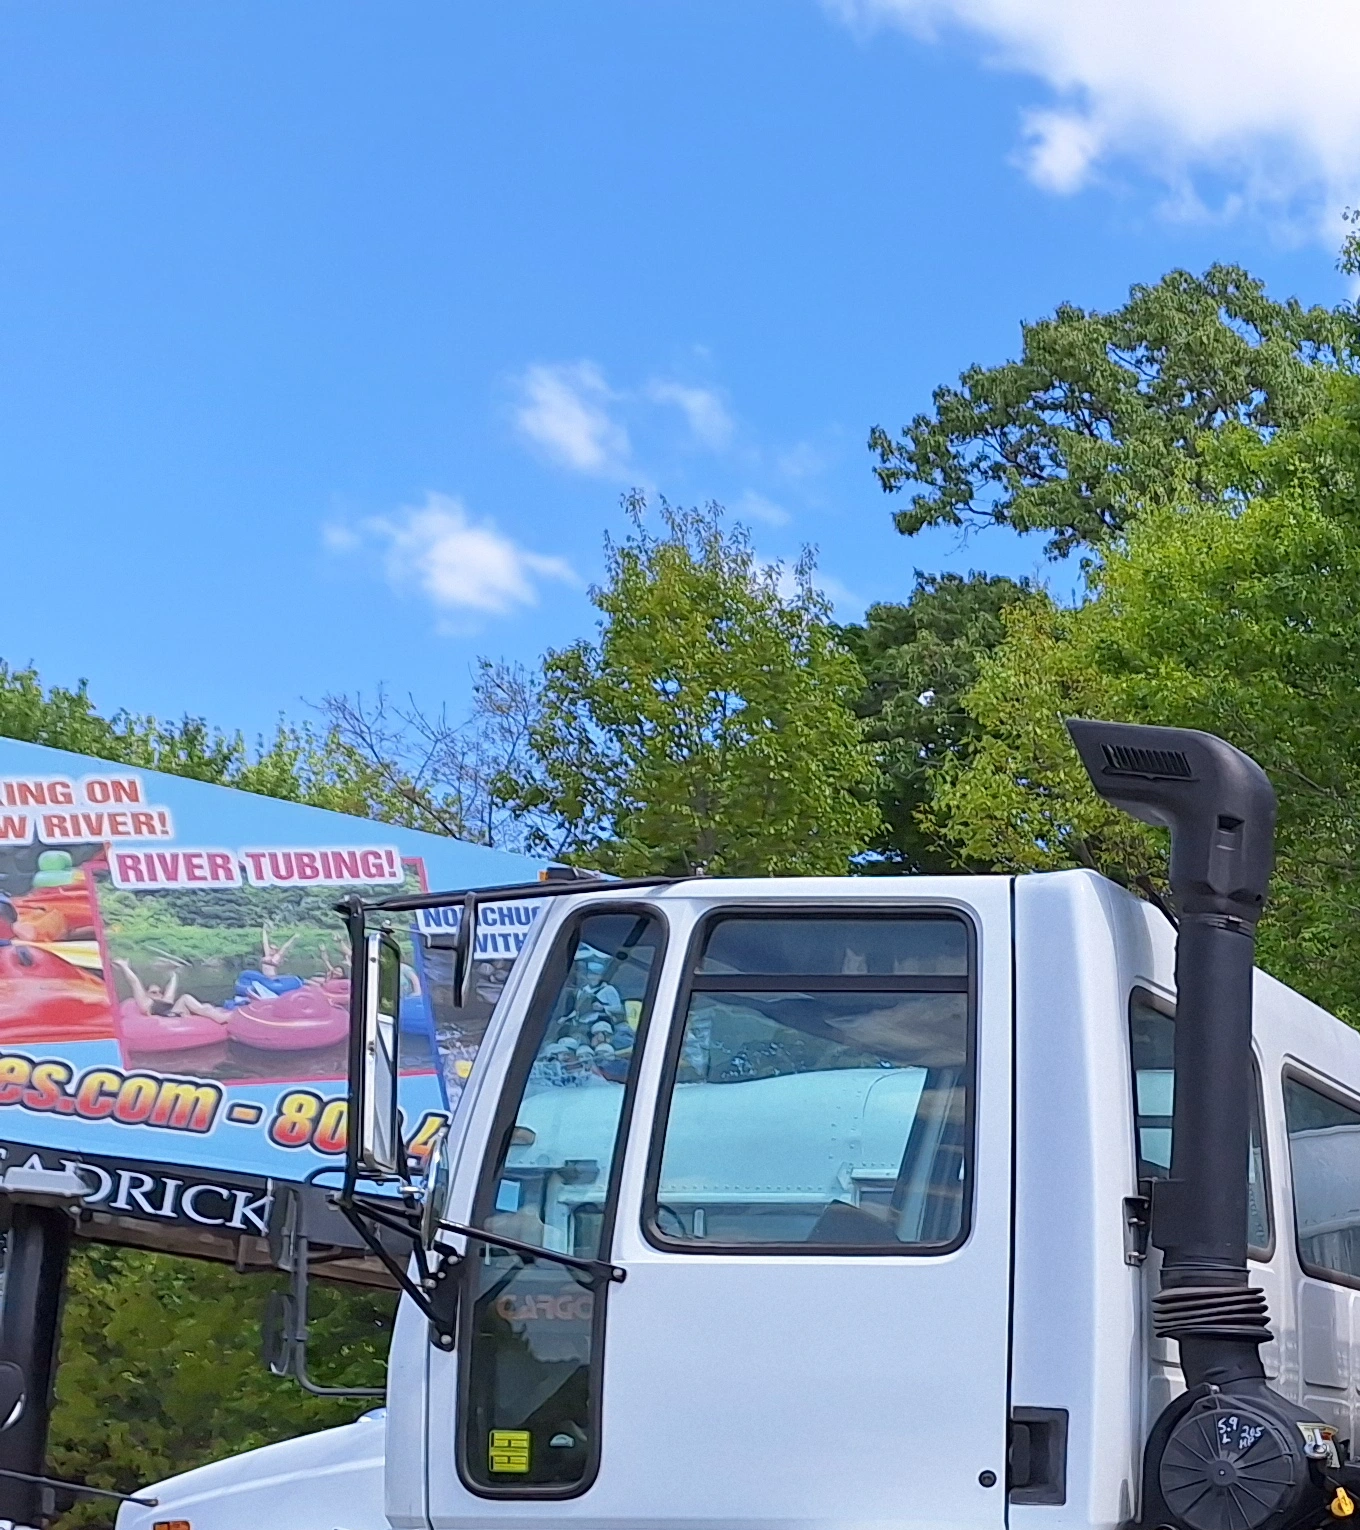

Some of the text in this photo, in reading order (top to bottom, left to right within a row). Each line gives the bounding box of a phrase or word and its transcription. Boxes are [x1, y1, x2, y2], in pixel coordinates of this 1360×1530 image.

[0, 779, 140, 806] ING ON
[43, 811, 169, 838] RIVER!
[116, 849, 397, 882] RIVER TUBING!
[1217, 1416, 1239, 1444] 5.9 L
[1239, 1436, 1255, 1449] HP
[1241, 1425, 1265, 1438] 205
